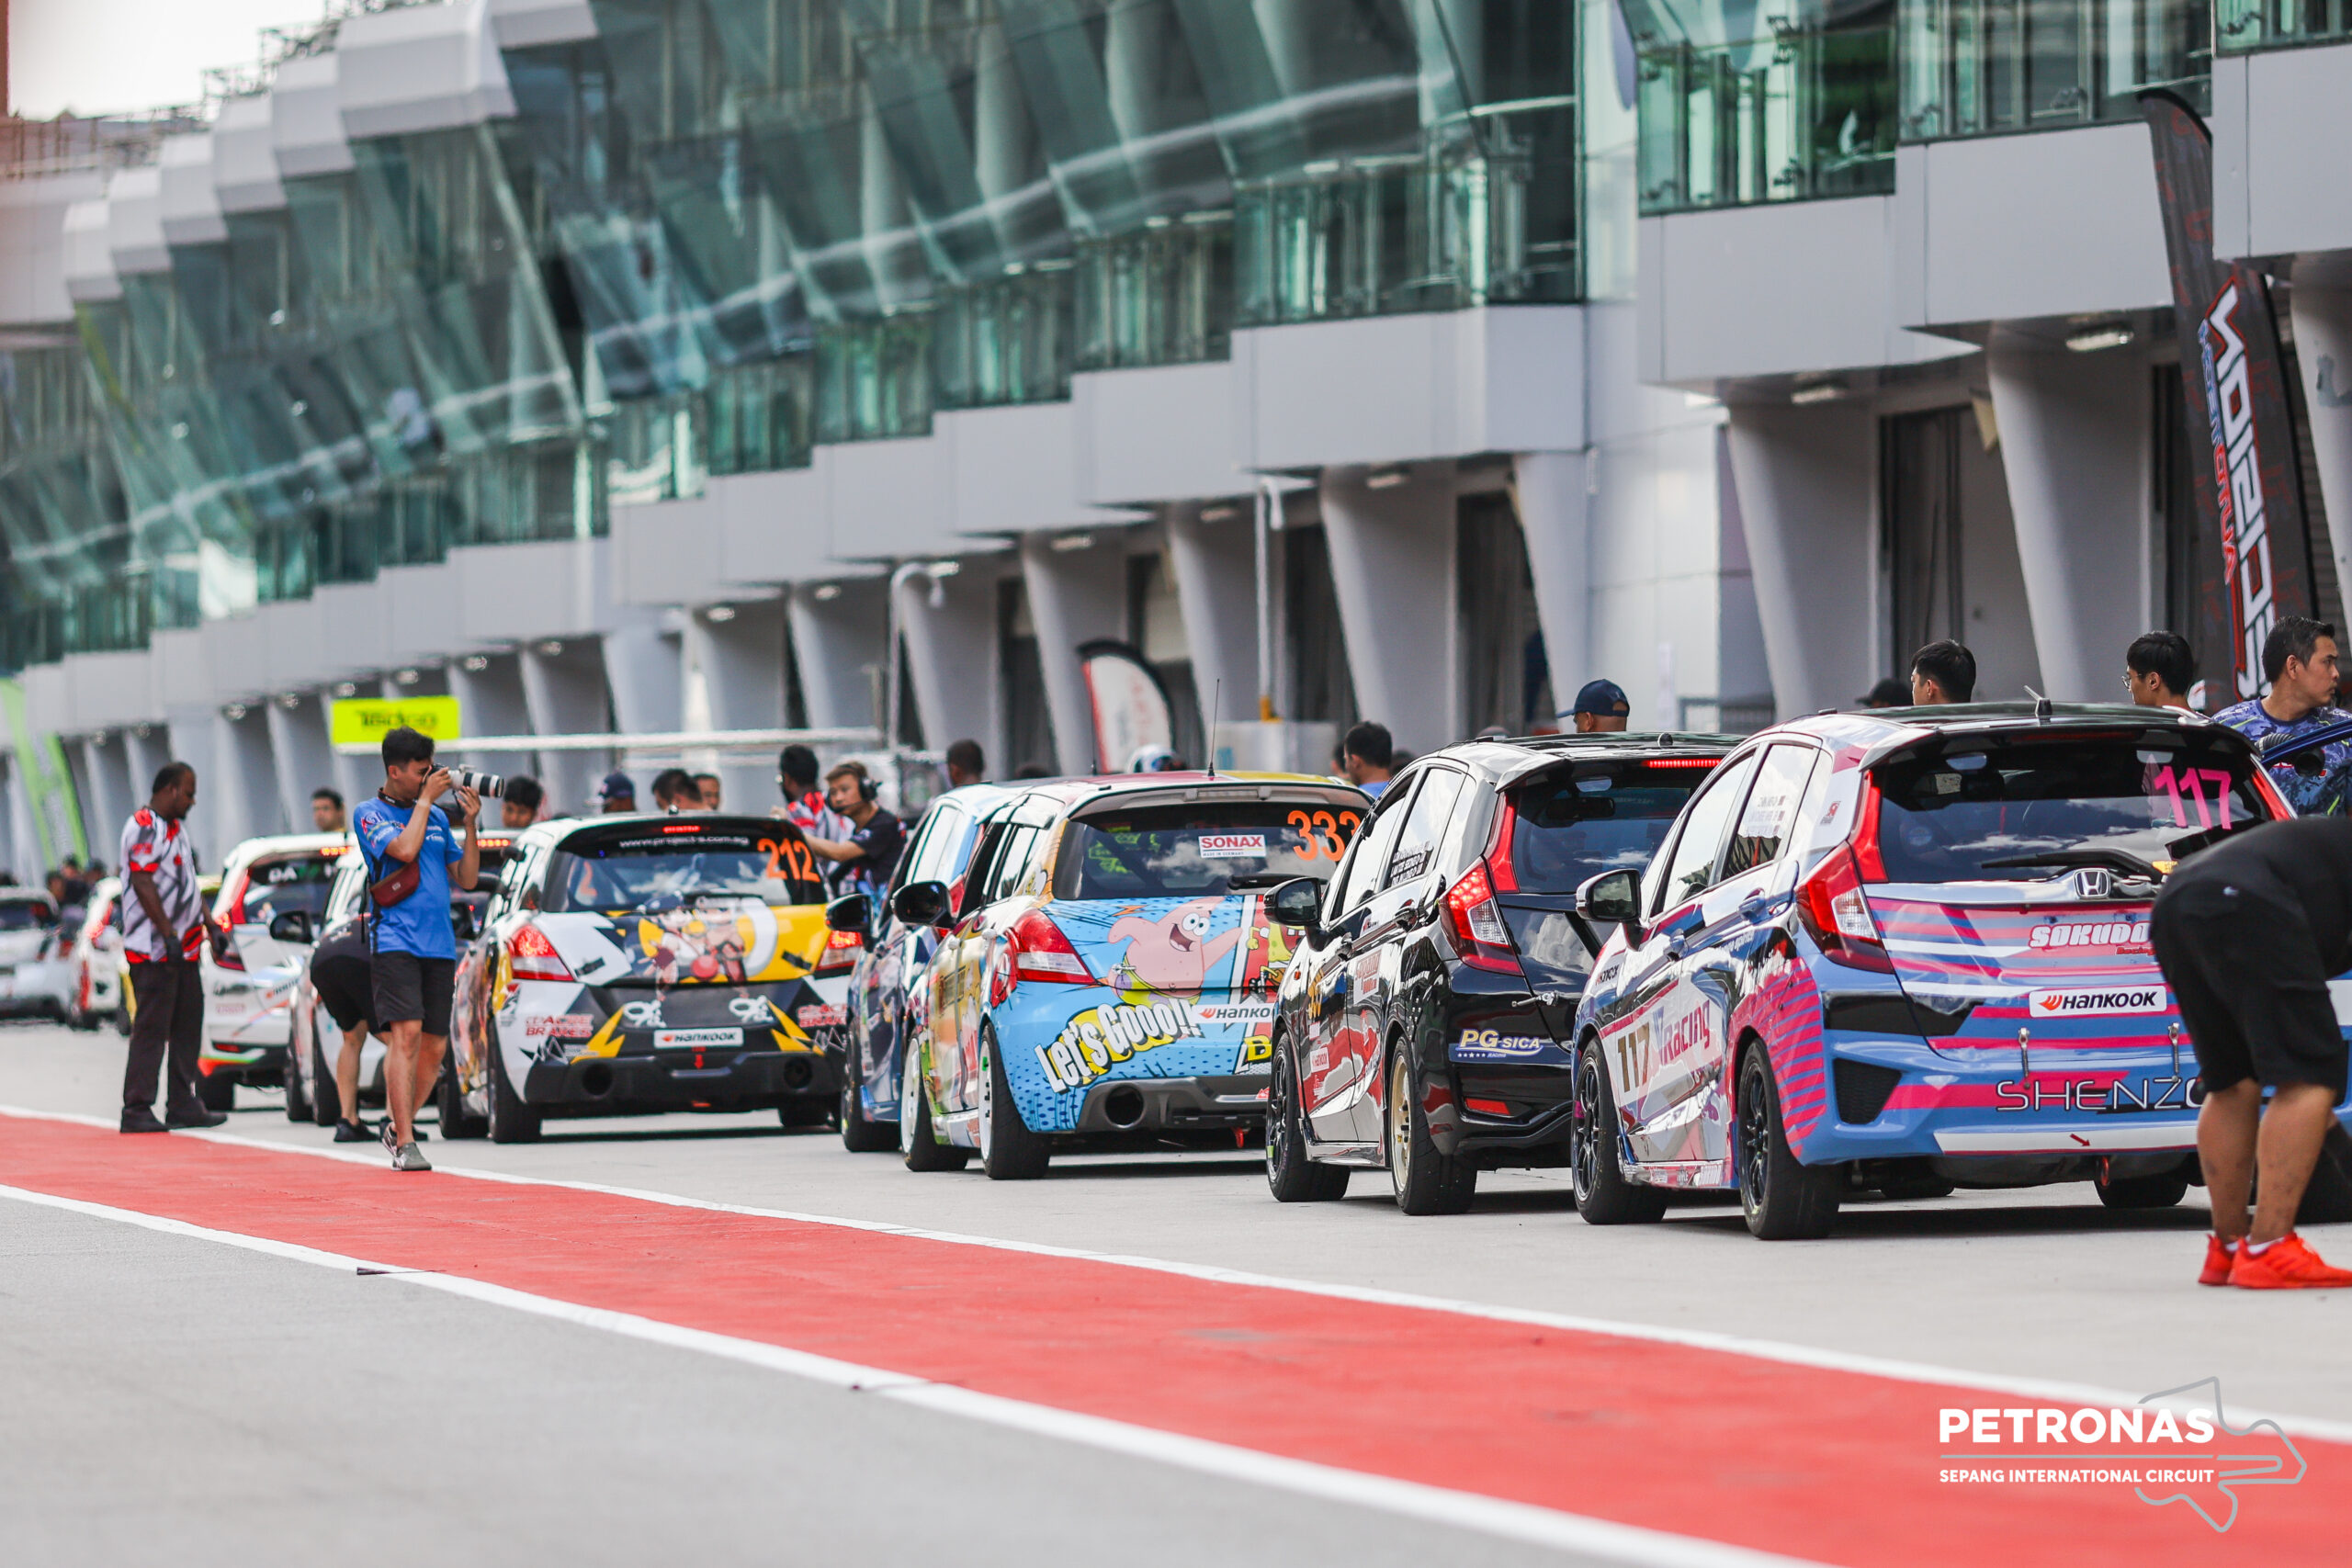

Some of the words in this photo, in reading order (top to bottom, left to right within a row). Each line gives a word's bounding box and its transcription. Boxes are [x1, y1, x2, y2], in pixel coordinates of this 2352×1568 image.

[2154, 765, 2232, 830] 117
[1201, 836, 1263, 849] SONAX
[757, 837, 821, 883] 212
[2029, 921, 2151, 948] SOKUDO
[1216, 1007, 1271, 1020] HANKO
[2062, 991, 2157, 1010] HANKOOK
[674, 1032, 736, 1043] HANKOOK
[1035, 1021, 1110, 1093] Let's
[1618, 1021, 1650, 1093] 117
